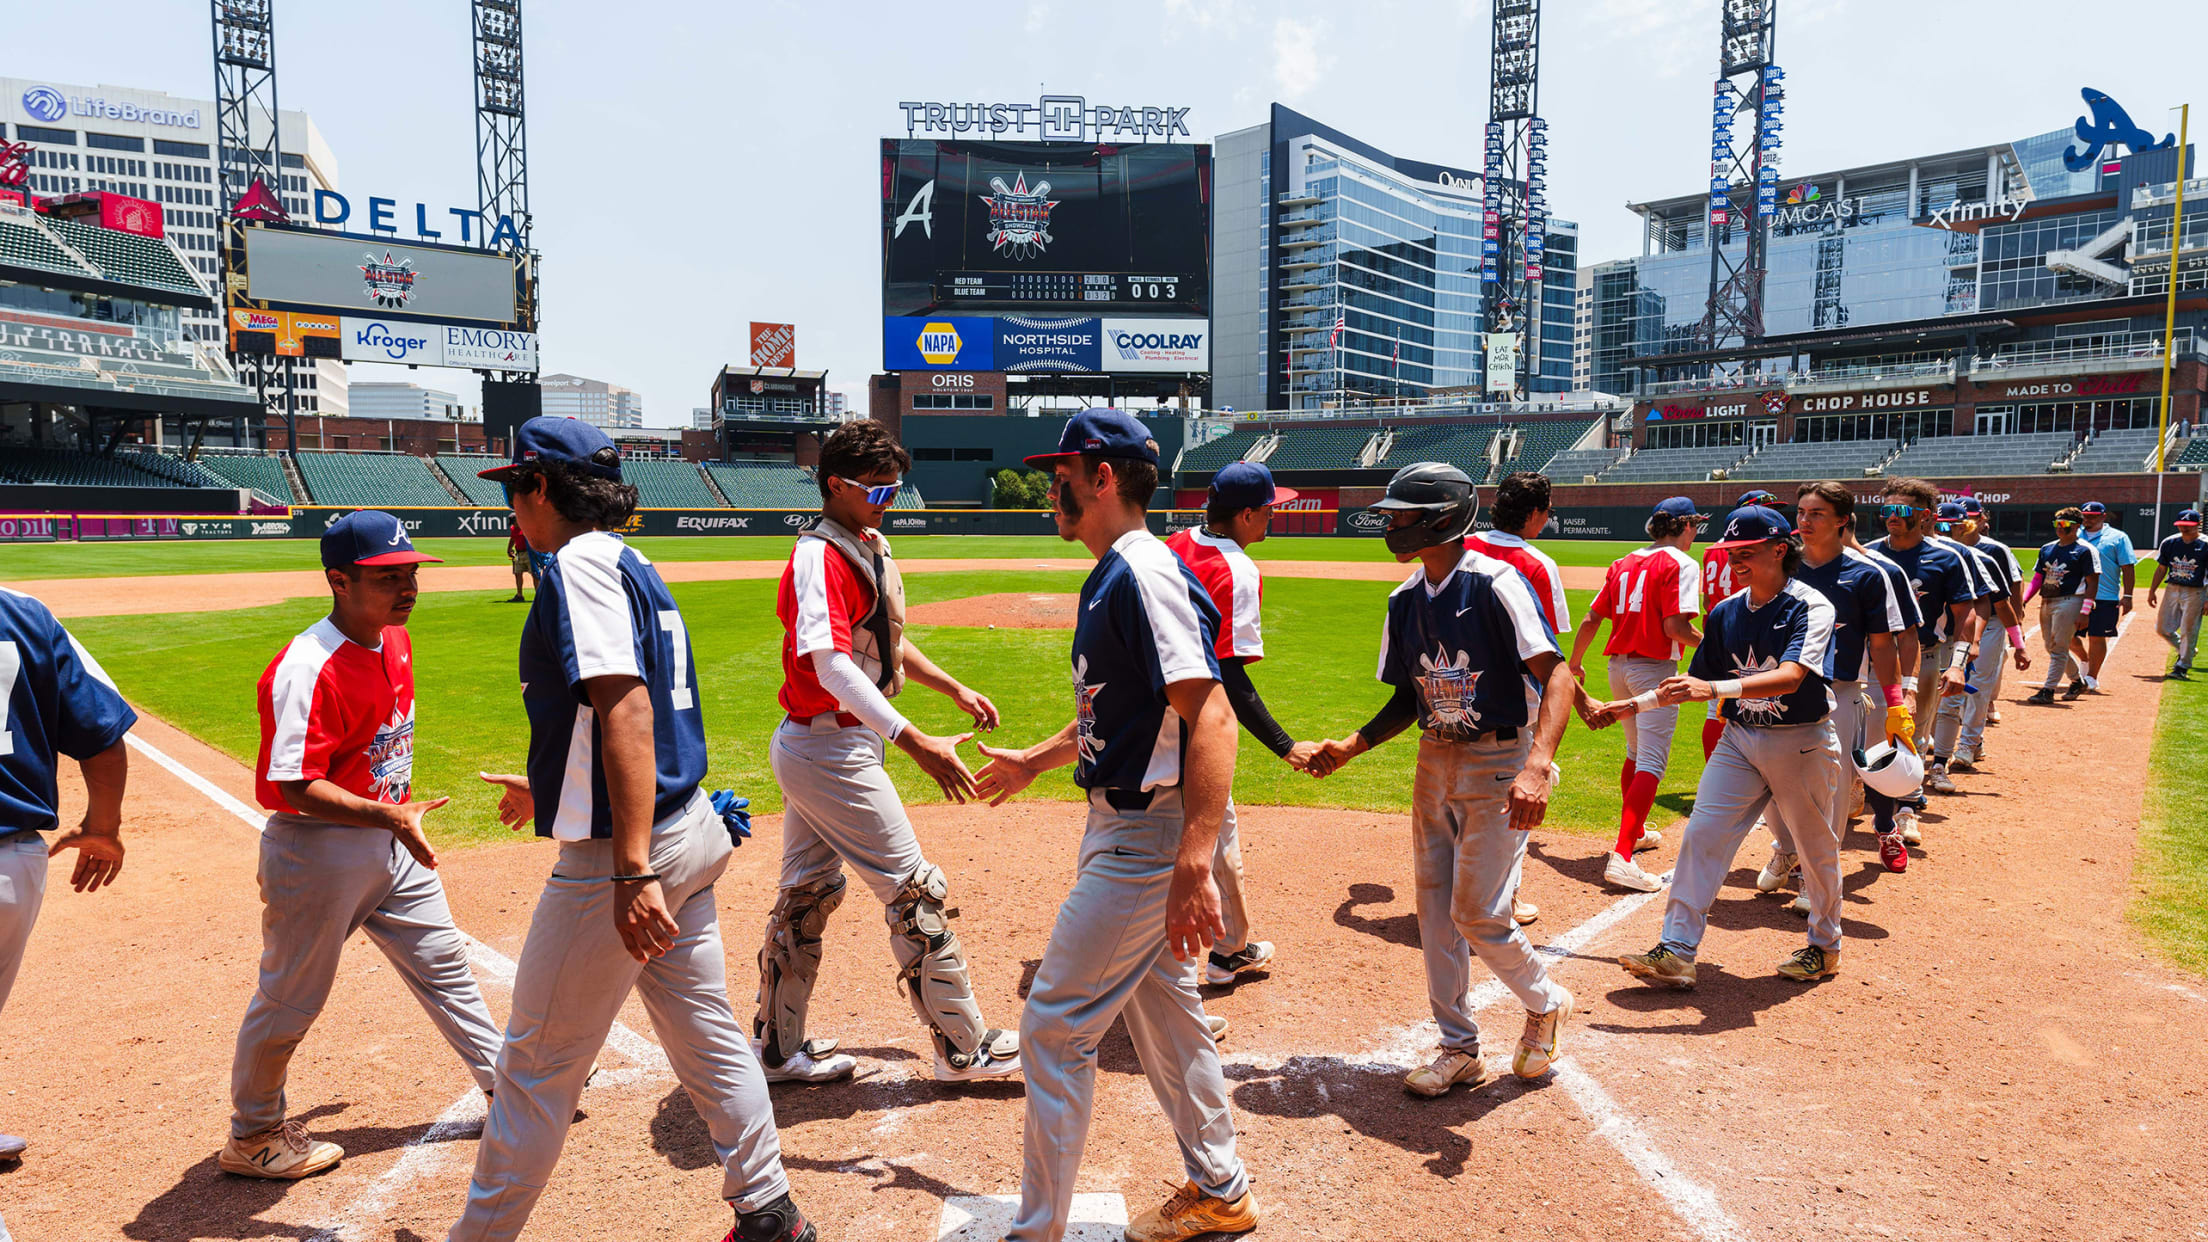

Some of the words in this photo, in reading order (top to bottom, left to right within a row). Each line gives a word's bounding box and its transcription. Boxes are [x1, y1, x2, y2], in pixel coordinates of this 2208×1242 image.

[71, 96, 200, 129] LifeBrand
[899, 102, 1032, 132] TRUIST
[1095, 106, 1191, 137] PARK
[1763, 154, 1777, 163] 2012
[1714, 164, 1727, 173] 2010
[1761, 188, 1775, 196] 2020
[894, 179, 935, 240] A
[1760, 205, 1774, 213] 2022
[1768, 195, 1868, 228] MCAST
[1929, 193, 2028, 229] xfinity
[314, 188, 525, 249] DELTA
[1712, 214, 1725, 222] 2021
[954, 277, 967, 285] RED
[967, 277, 983, 285] TEAM
[954, 288, 970, 296] BLUE
[971, 288, 985, 296] TEAM
[1132, 284, 1141, 298] 0
[1149, 284, 1159, 298] 0
[1166, 284, 1176, 299] 3
[249, 313, 279, 324] MEGA
[357, 323, 427, 359] Kroger
[447, 327, 531, 350] EMORY
[755, 328, 773, 345] THE
[924, 334, 955, 352] NAPA
[1003, 334, 1092, 345] NORTHSIDE
[1116, 333, 1203, 350] COOLRAY
[751, 324, 795, 366] HOME
[1019, 347, 1076, 355] HOSPITAL
[448, 348, 529, 361] HEALTHCARE
[768, 341, 795, 368] DEPOT
[1493, 354, 1510, 362] MOR
[1489, 362, 1512, 371] CHIKIN
[932, 374, 974, 387] ORIS
[2006, 385, 2049, 397] MADE
[2053, 383, 2073, 394] TO
[2078, 372, 2145, 396] Chill
[1803, 396, 1854, 411] CHOP
[1862, 390, 1930, 408] HOUSE
[1663, 404, 1706, 420] Coors
[1706, 404, 1747, 418] LIGHT
[1974, 491, 2011, 503] CHOP
[2139, 508, 2155, 516] 325
[457, 511, 508, 535] xfini
[677, 517, 750, 530] EQUIFAX
[1354, 514, 1385, 526] Ford
[1564, 518, 1586, 526] KAISER
[1706, 561, 1732, 596] 24
[1615, 570, 1648, 615] 14
